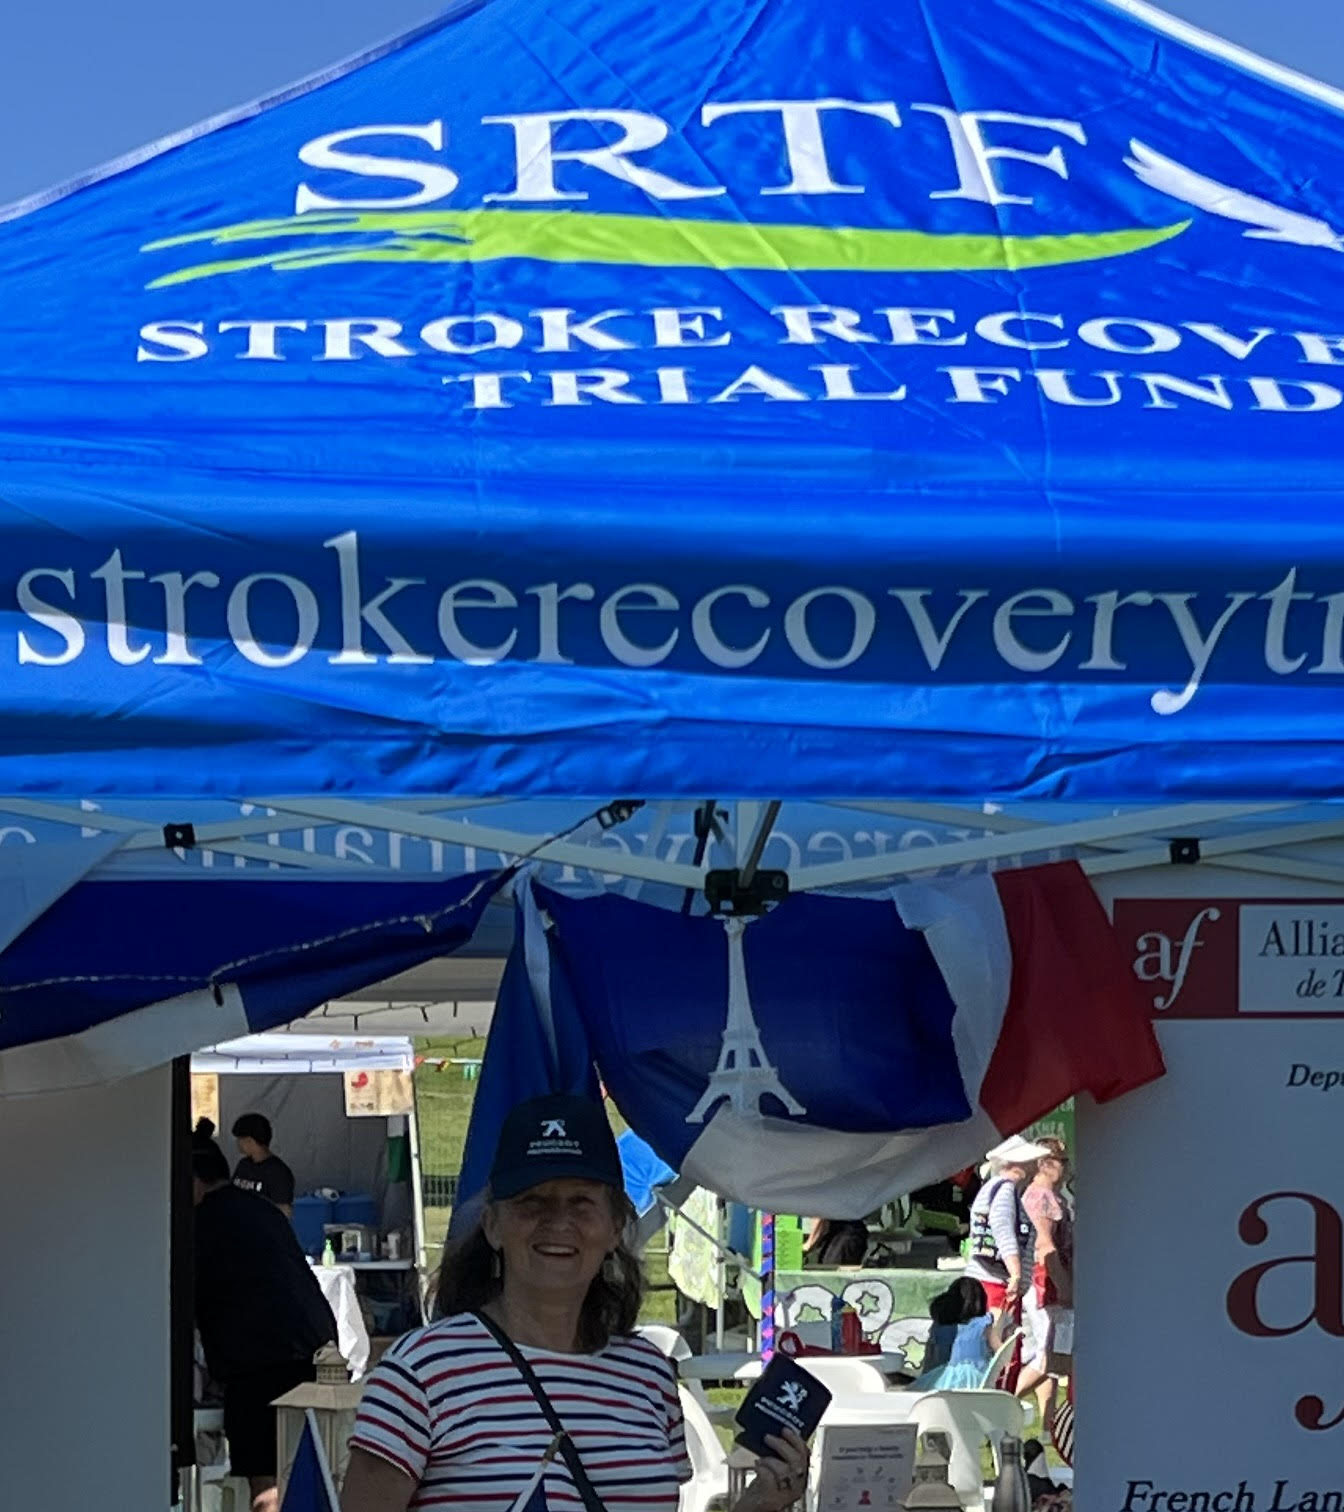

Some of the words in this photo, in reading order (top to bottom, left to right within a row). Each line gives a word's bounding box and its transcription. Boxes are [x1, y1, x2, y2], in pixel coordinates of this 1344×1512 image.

[294, 100, 1087, 213] SRTF
[136, 305, 731, 362] STROKE
[442, 365, 908, 410] TRIAL
[1133, 907, 1221, 1010] af
[1296, 970, 1327, 998] de
